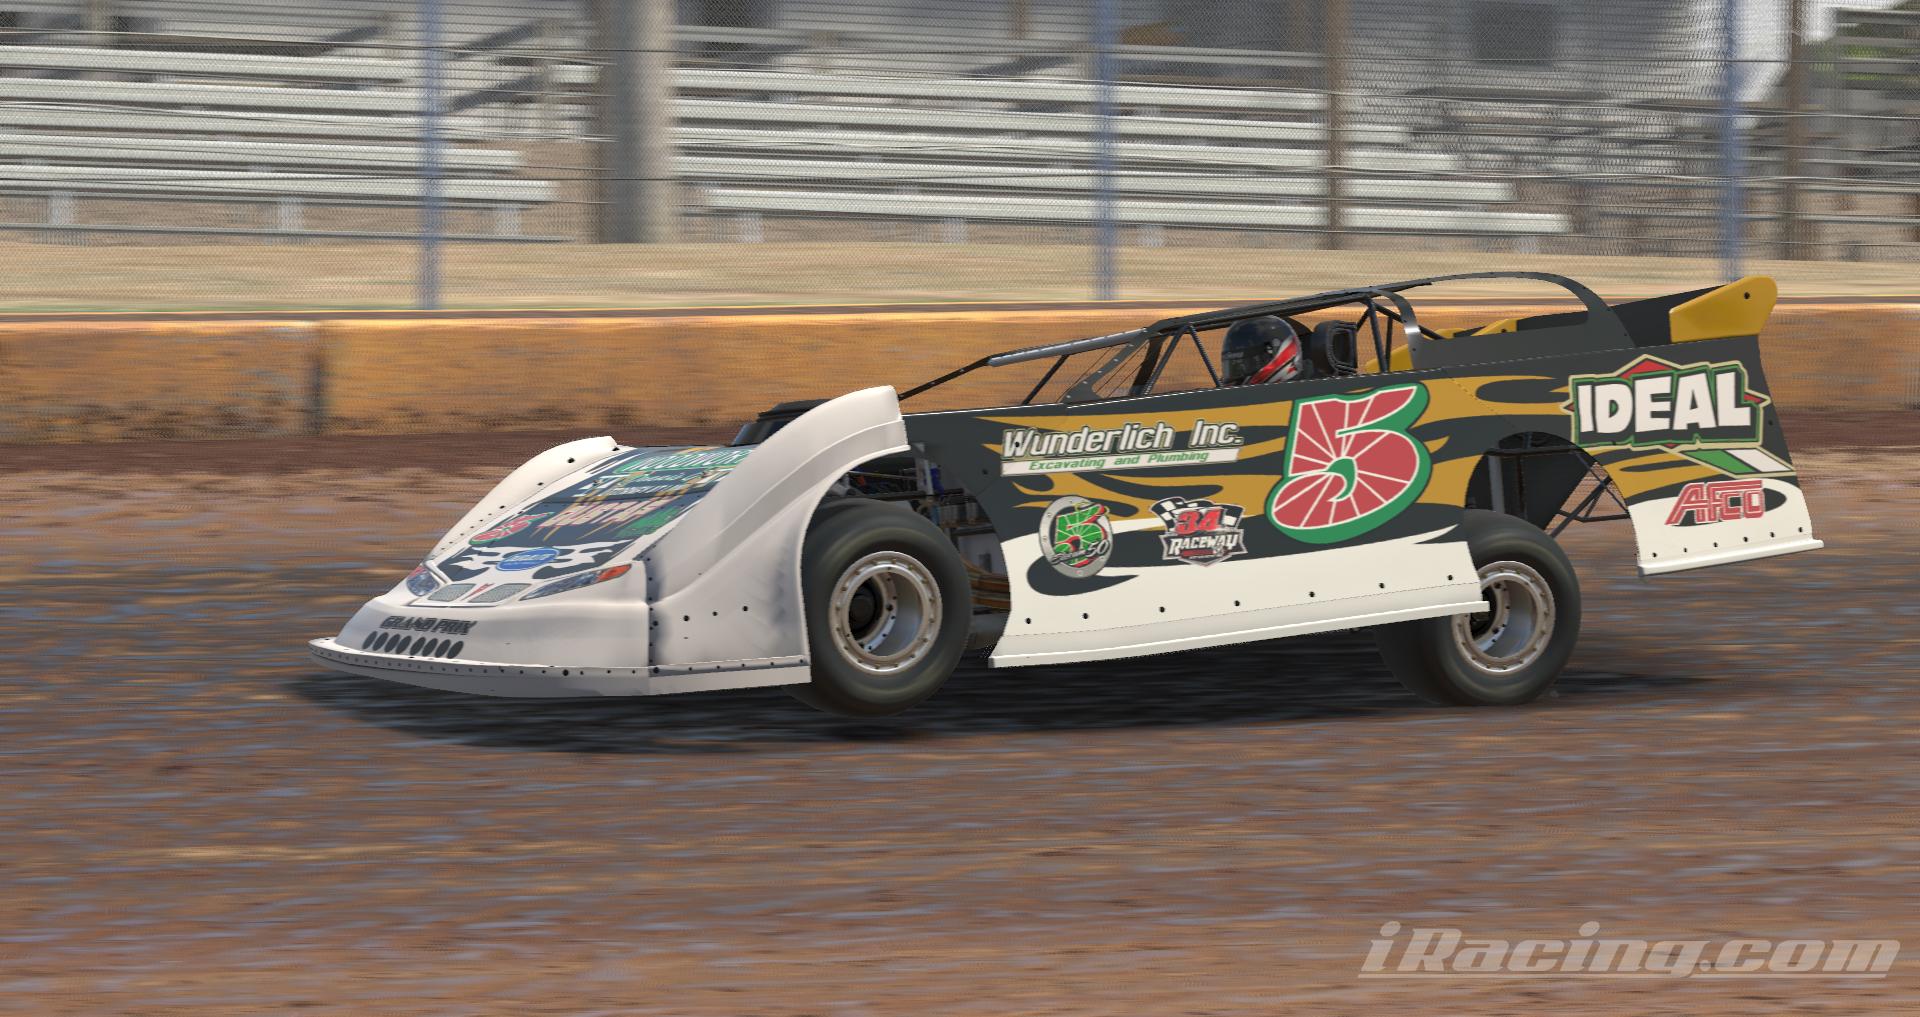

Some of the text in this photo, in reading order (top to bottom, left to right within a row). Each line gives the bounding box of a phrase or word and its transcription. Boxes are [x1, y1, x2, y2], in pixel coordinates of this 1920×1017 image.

[1577, 372, 1752, 434] IDEAL
[1003, 419, 1243, 457] Wunderlich Inc.
[1028, 451, 1209, 471] Excavating and Plumbing
[1268, 384, 1430, 542] 5
[1664, 480, 1766, 525] AFCO
[1175, 508, 1225, 534] 34
[1087, 539, 1110, 558] 50
[1168, 533, 1239, 556] RACEWAY
[379, 615, 478, 636] GRAND PRIX
